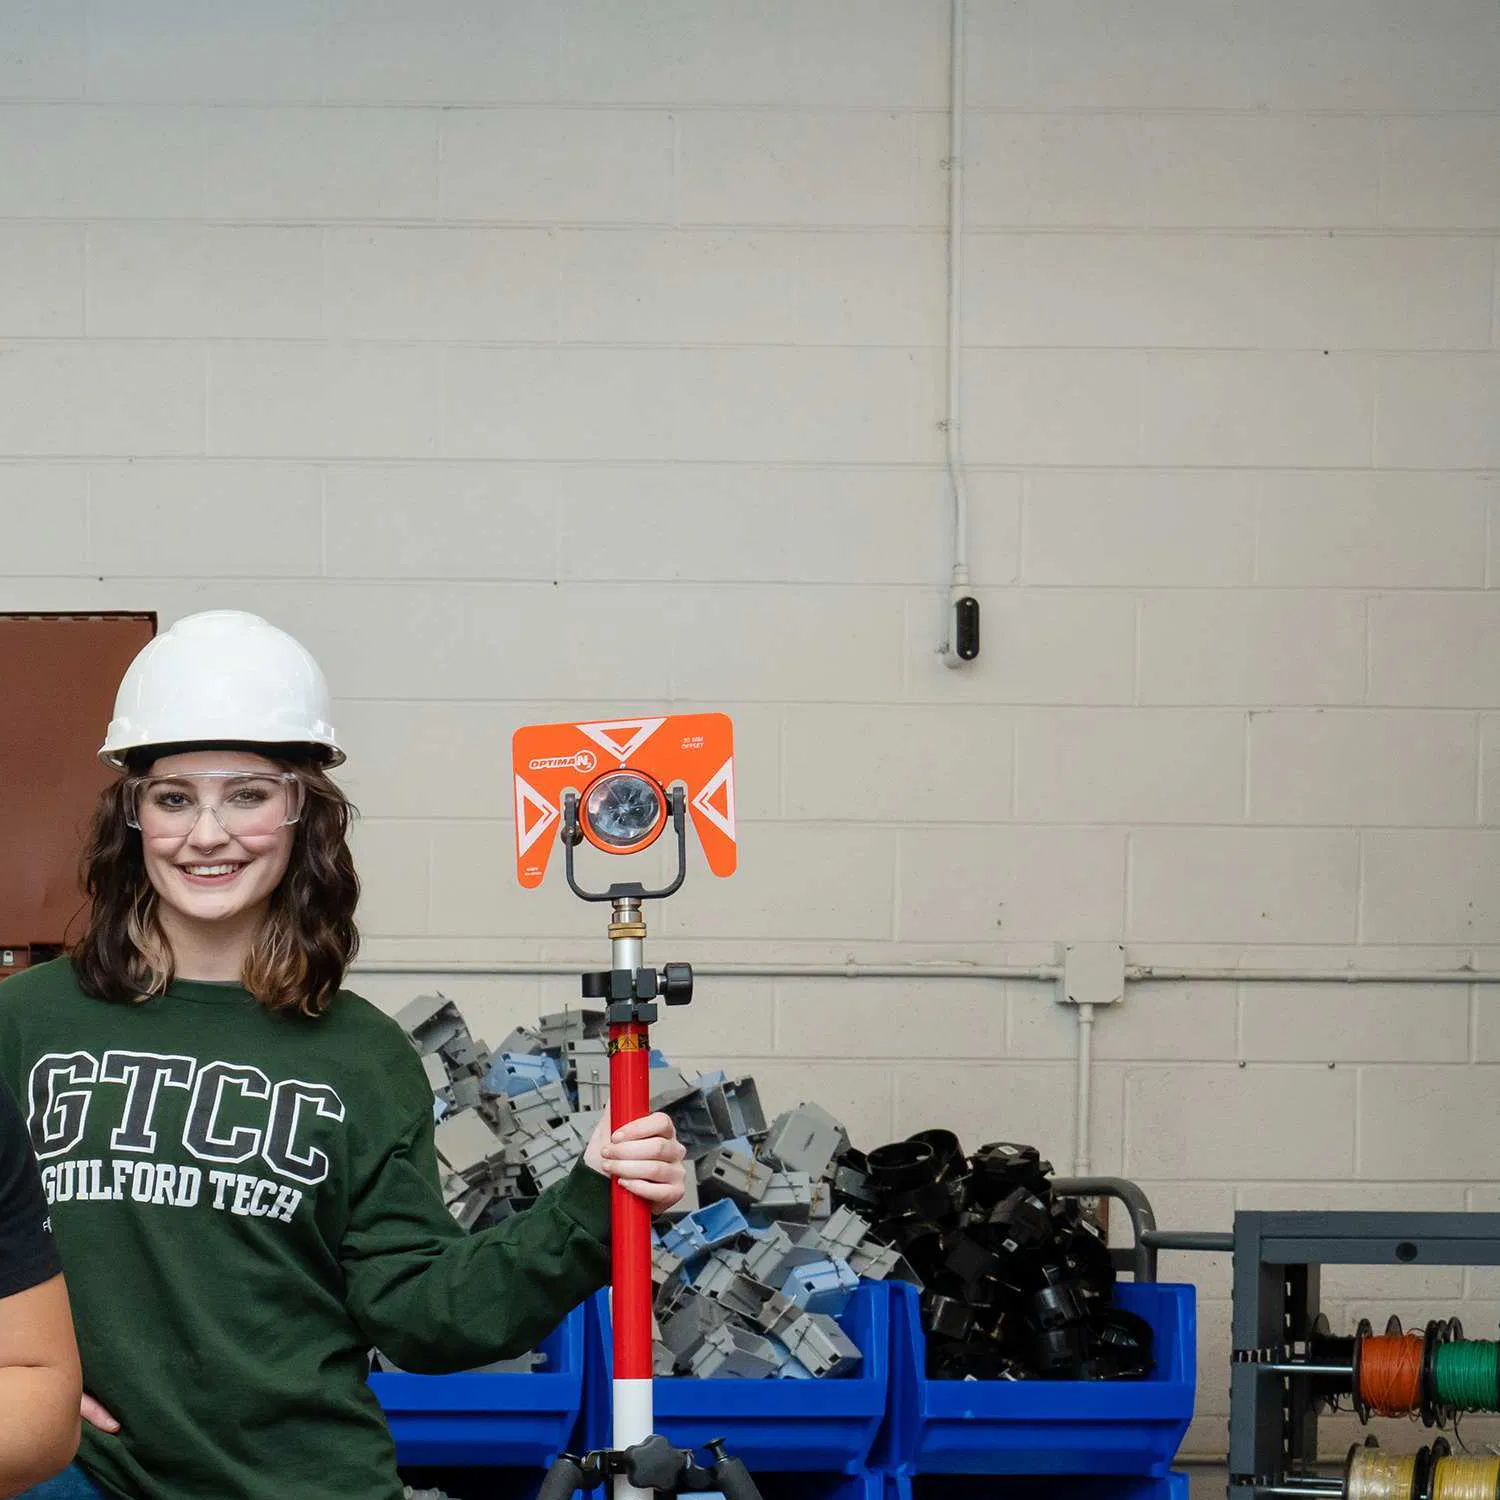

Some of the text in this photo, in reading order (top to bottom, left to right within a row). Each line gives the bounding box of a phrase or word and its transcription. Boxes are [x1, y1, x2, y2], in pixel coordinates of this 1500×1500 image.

[27, 1050, 345, 1185] GTCC
[42, 1160, 303, 1223] GUILFORD TECH
